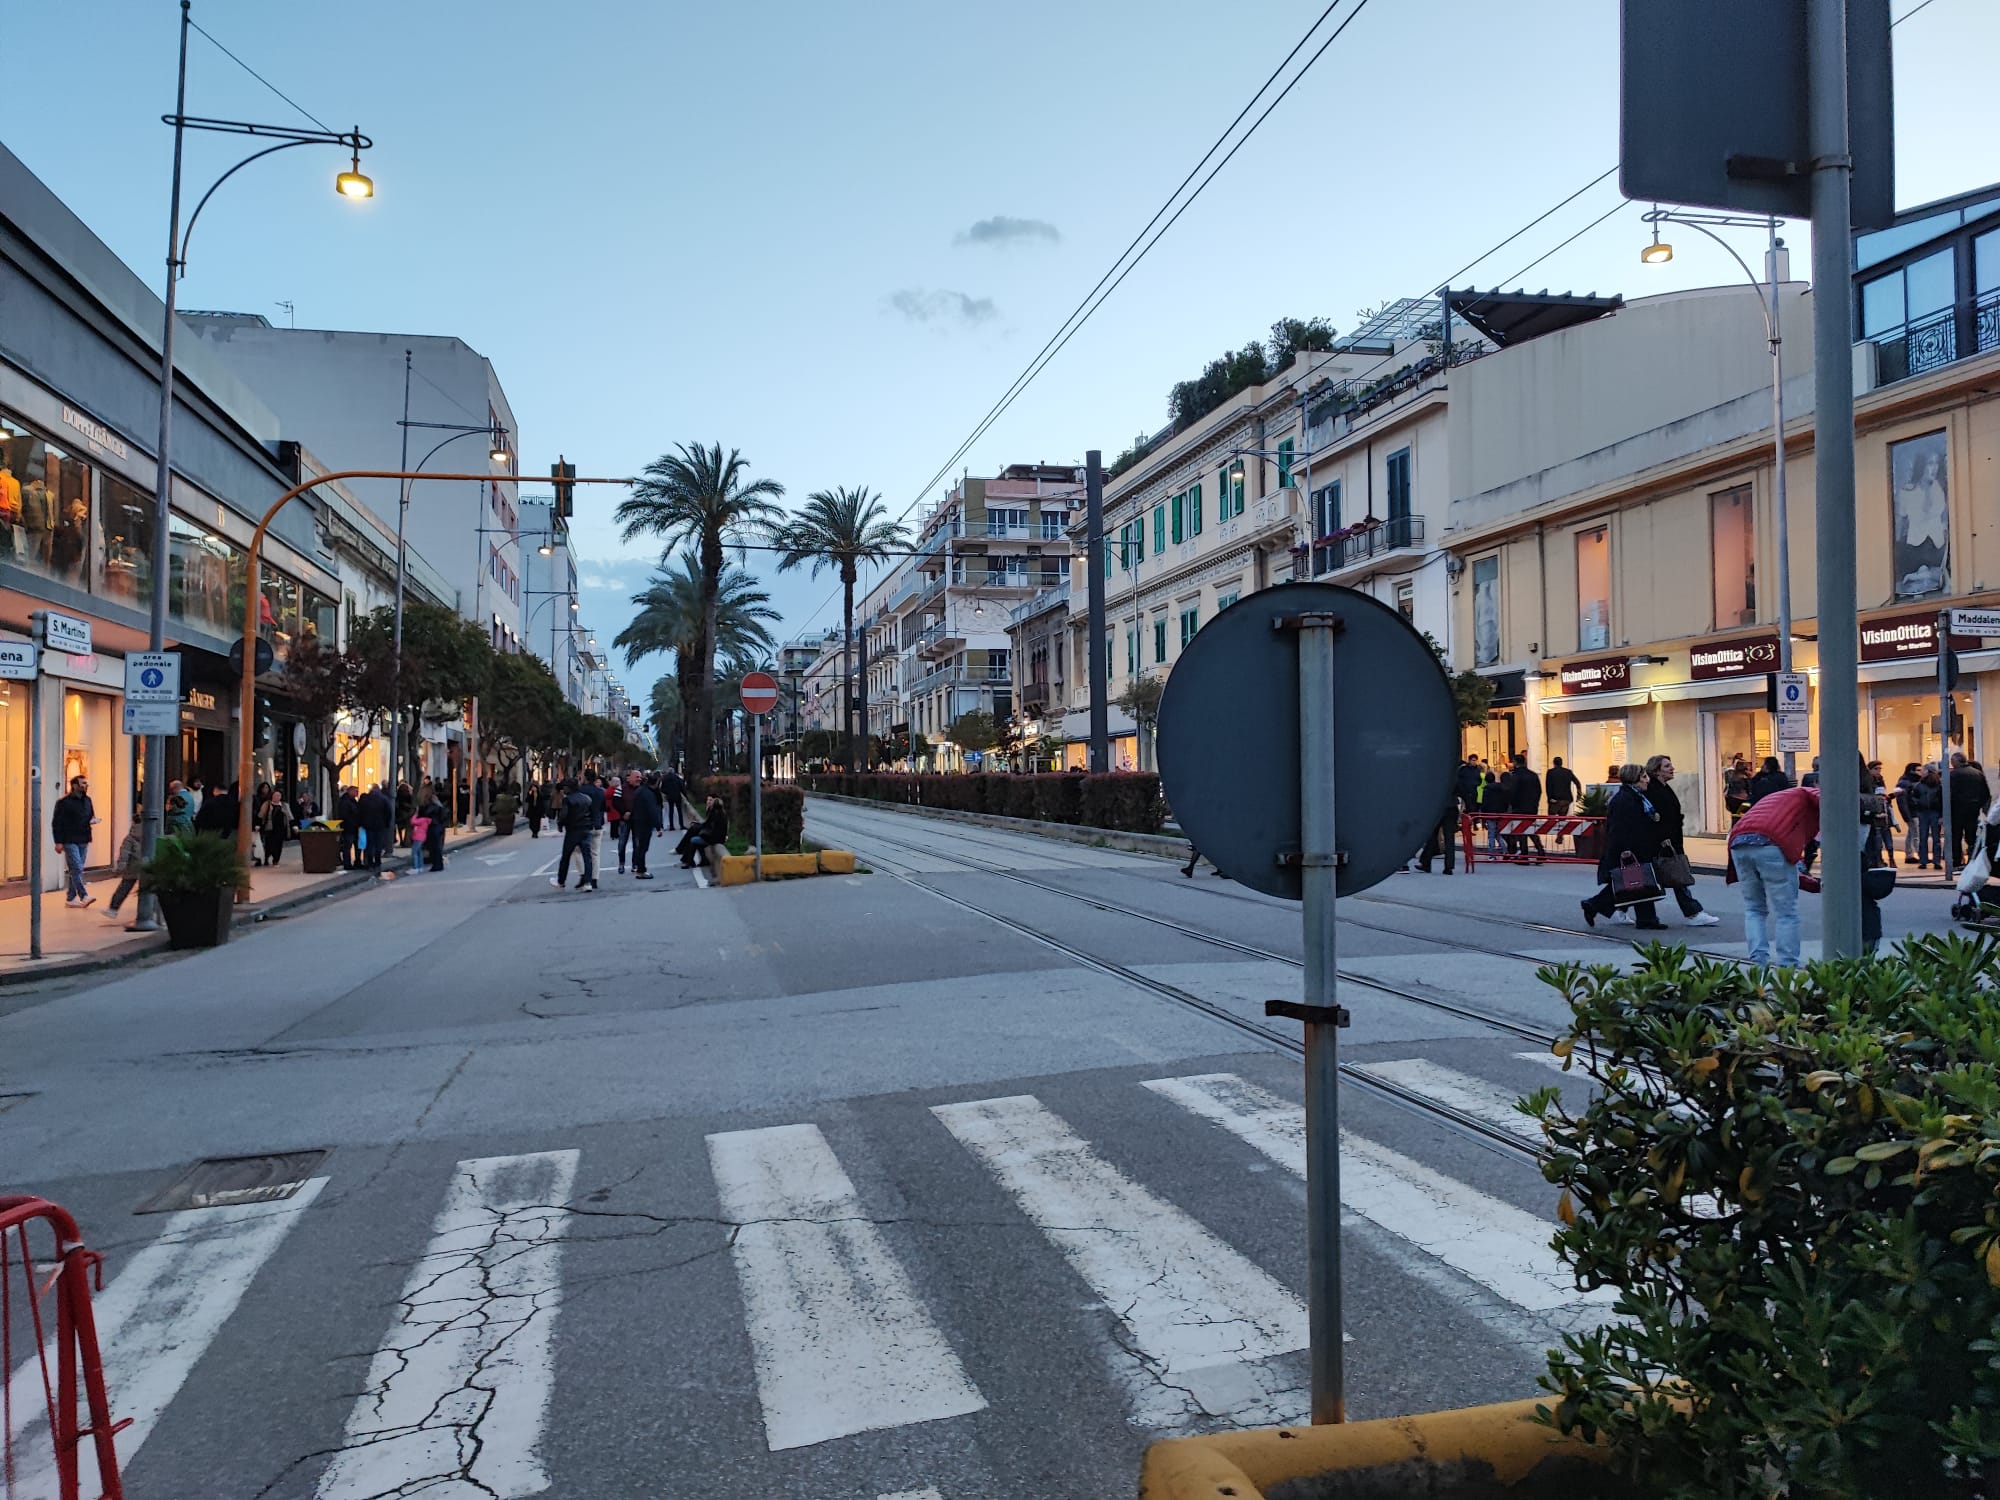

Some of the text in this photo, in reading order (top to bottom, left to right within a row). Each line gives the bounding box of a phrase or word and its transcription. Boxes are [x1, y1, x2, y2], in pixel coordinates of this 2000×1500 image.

[53, 619, 86, 639] S. Martino
[1861, 623, 1932, 645] VisionOttica
[1691, 649, 1744, 666] VisionOttica
[1561, 668, 1602, 683] VisionOttica
